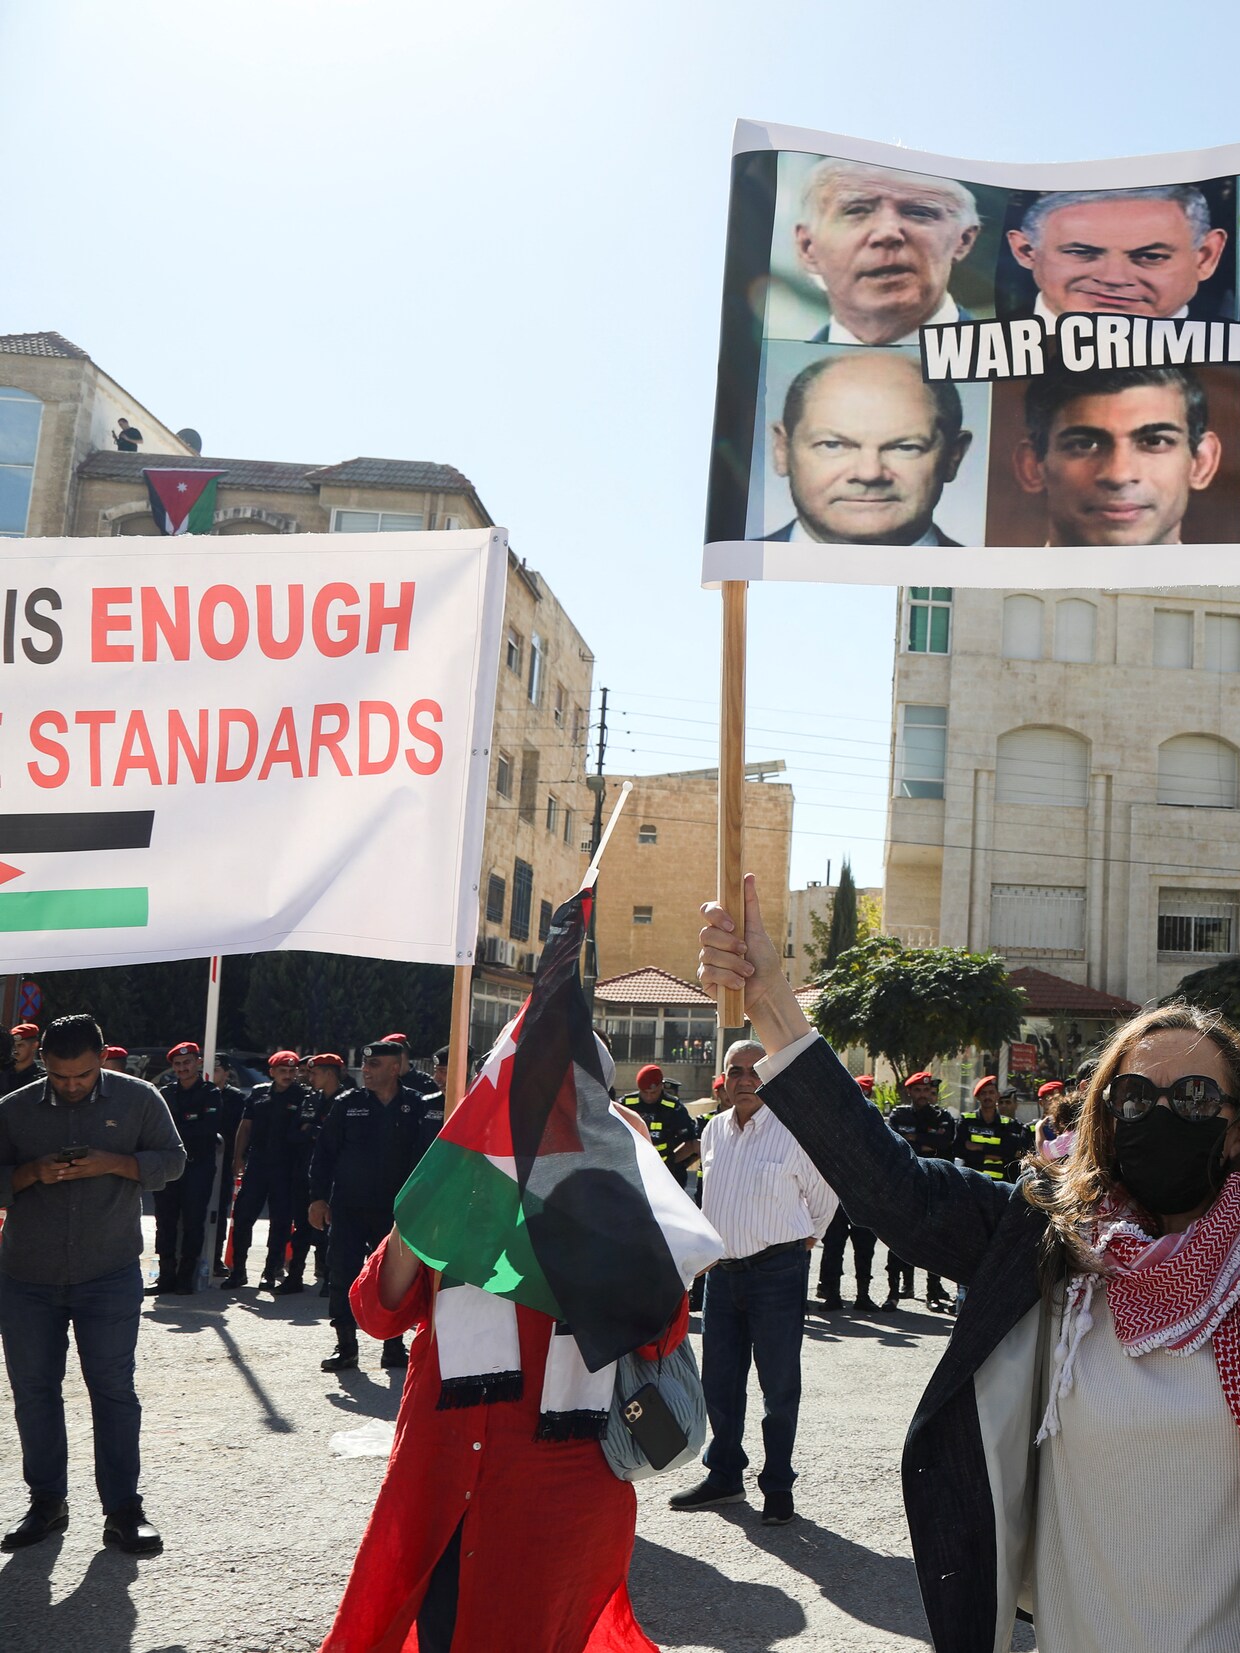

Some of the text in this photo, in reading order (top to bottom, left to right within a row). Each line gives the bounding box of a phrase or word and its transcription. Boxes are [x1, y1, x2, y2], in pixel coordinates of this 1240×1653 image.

[923, 318, 1045, 380] WAR
[2, 581, 416, 665] IS ENOUGH
[26, 698, 444, 789] STANDARDS
